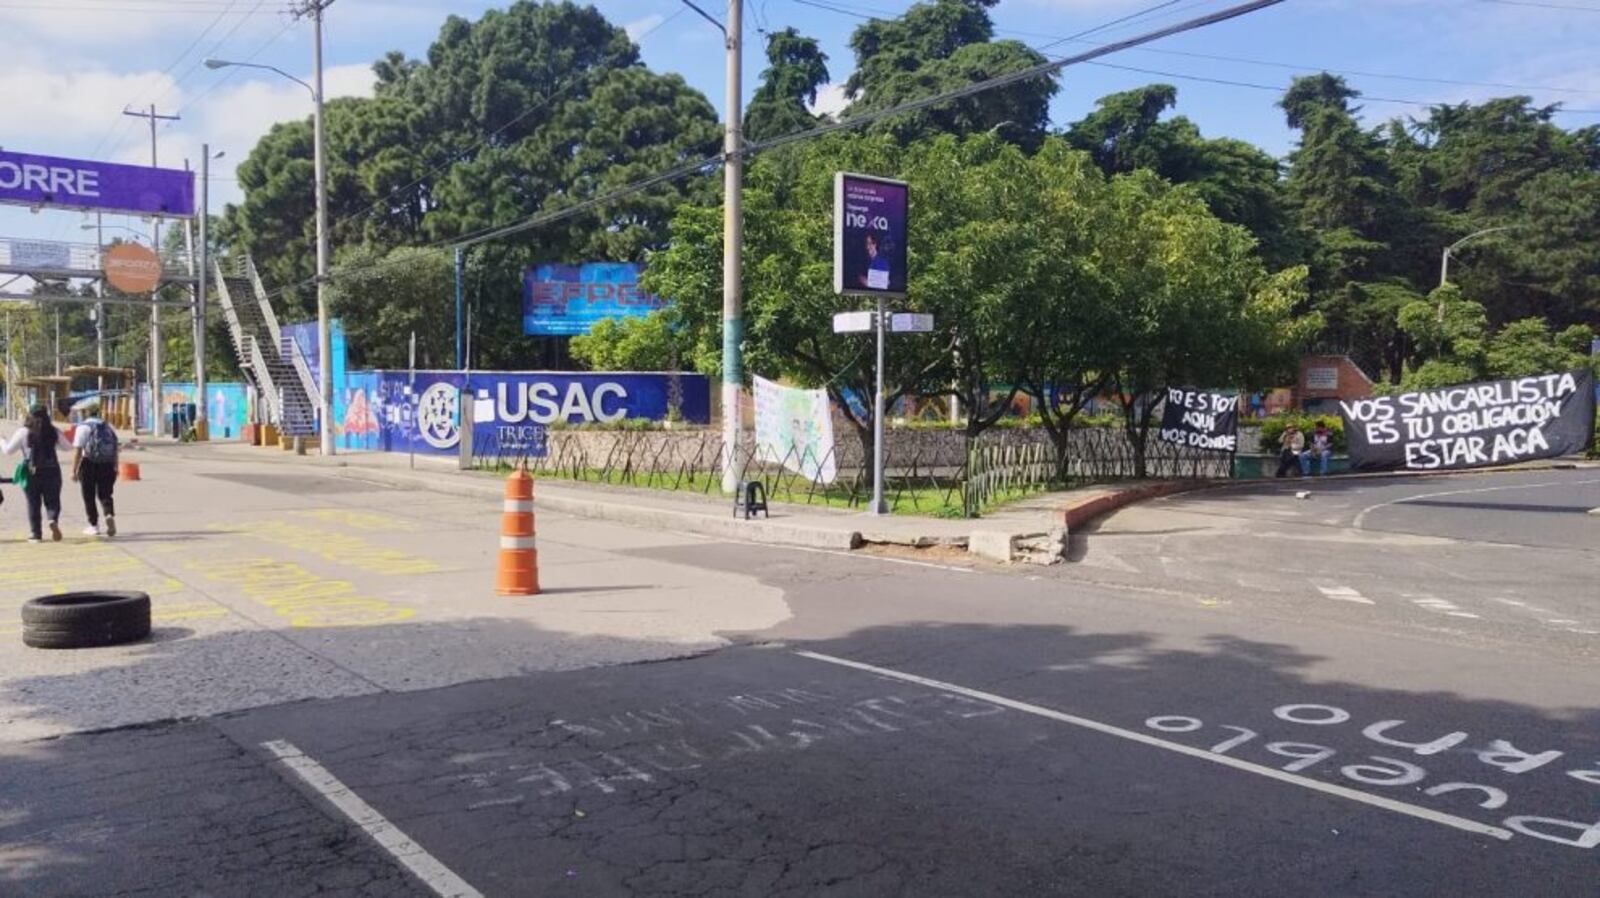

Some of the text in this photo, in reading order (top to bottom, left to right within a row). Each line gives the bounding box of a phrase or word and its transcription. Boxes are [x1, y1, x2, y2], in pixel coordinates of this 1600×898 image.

[846, 212, 888, 230] nexa
[497, 382, 627, 424] USAC
[1340, 373, 1577, 422] VOS SANCARLISTA
[1162, 428, 1187, 444] VOS
[1365, 397, 1562, 444] ES TU OBLIGACIÓN
[1405, 421, 1549, 469] ESTAR ACÁ
